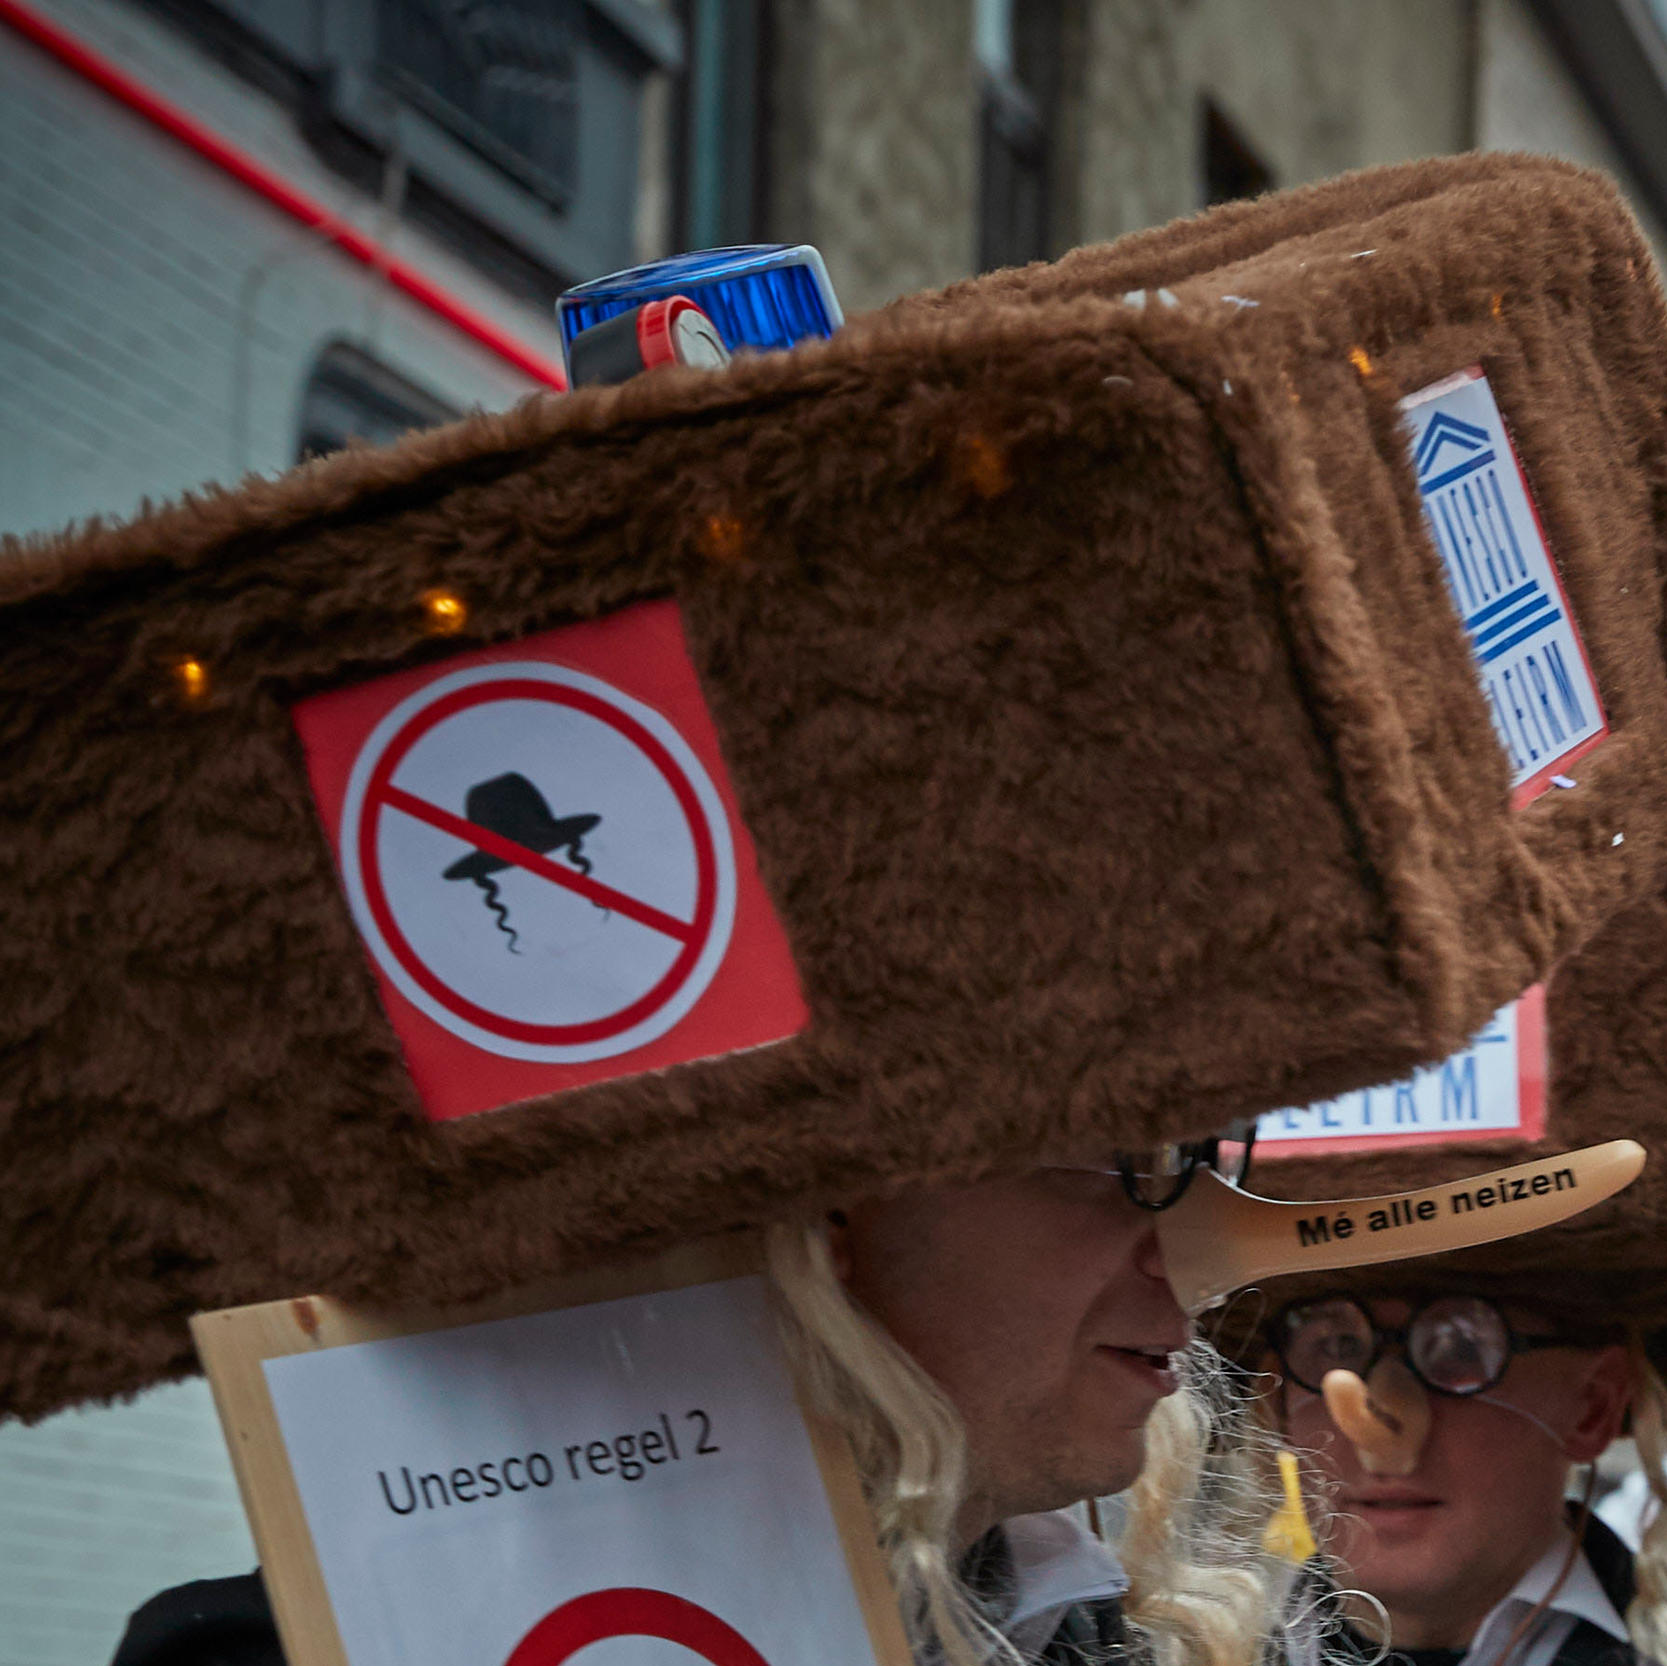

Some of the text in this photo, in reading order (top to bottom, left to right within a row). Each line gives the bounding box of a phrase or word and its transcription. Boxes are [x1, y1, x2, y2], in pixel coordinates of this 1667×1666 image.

[1490, 640, 1589, 770] LEIRM
[1296, 1167, 1577, 1247] Mé alle neizen
[378, 1408, 720, 1516] Unesco regel 2
